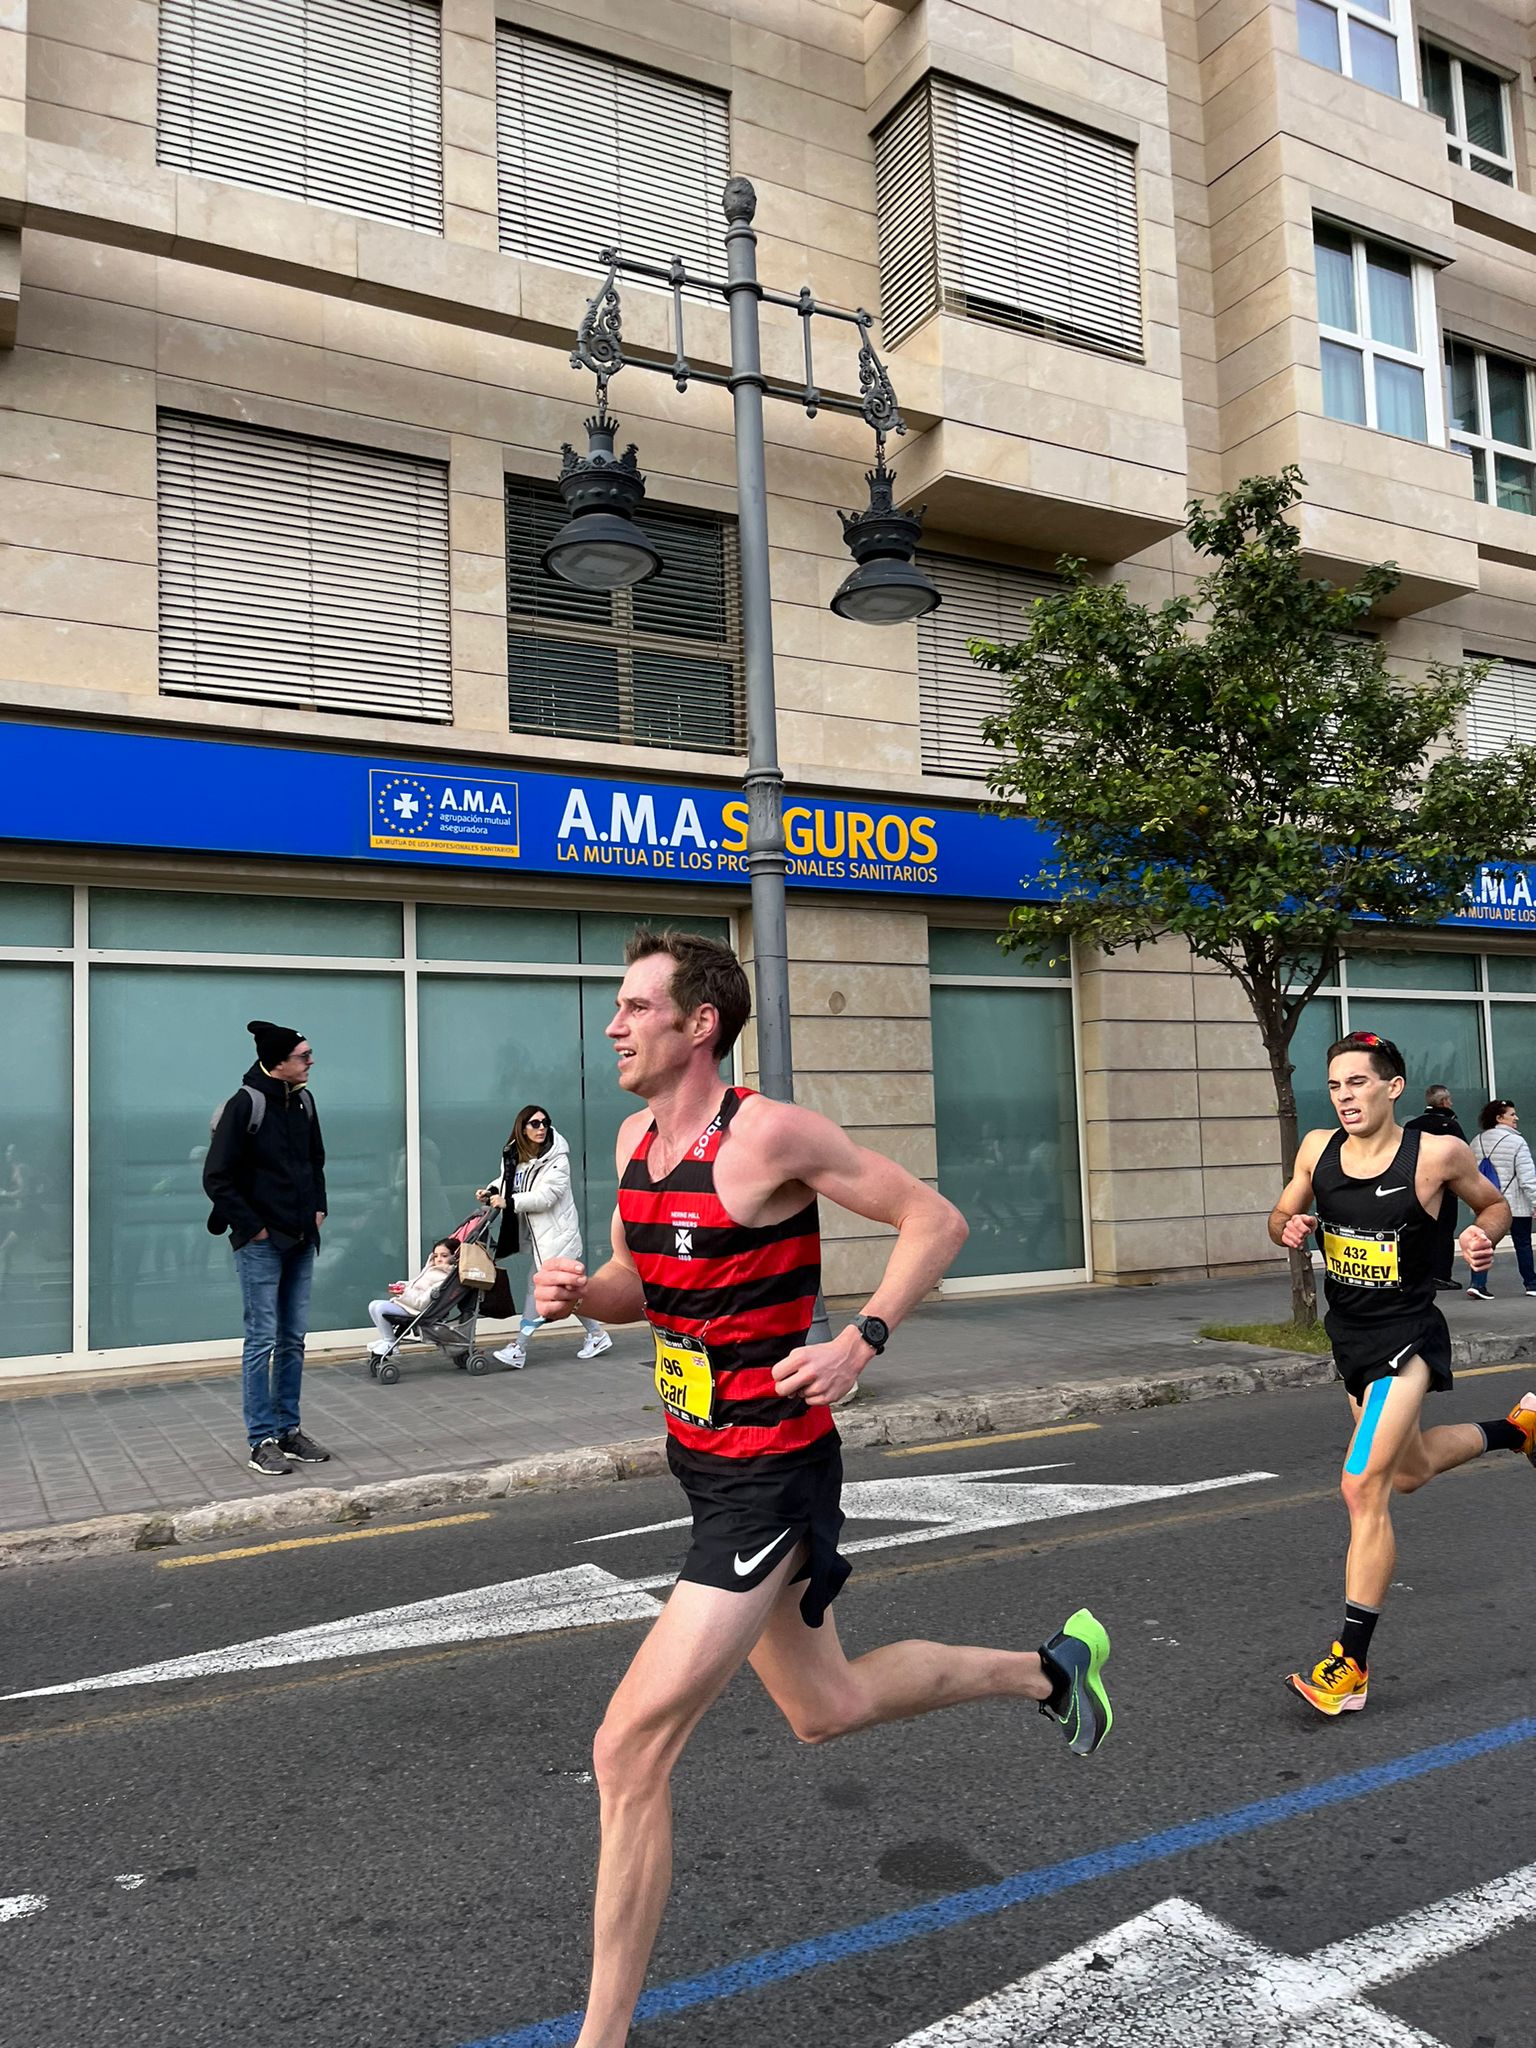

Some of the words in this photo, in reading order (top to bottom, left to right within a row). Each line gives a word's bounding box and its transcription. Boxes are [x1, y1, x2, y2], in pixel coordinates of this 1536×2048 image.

[440, 787, 512, 815] A.M.A.
[440, 813, 482, 824] agrupación
[484, 816, 511, 826] mutual
[440, 824, 488, 835] aseguradora
[721, 801, 938, 864] SGUROS
[557, 843, 579, 862] LA
[584, 846, 648, 866] MUTUA
[653, 850, 676, 868] DE
[680, 852, 712, 870] LOS
[717, 853, 845, 878] PROONALES
[849, 862, 938, 883] SANITARIOS
[1468, 906, 1502, 920] MUTUA
[1504, 909, 1517, 921] DE
[1518, 909, 1536, 922] LOS
[1344, 1246, 1367, 1260] 432
[1330, 1257, 1391, 1279] TRACKEV
[660, 1377, 687, 1407] Carl
